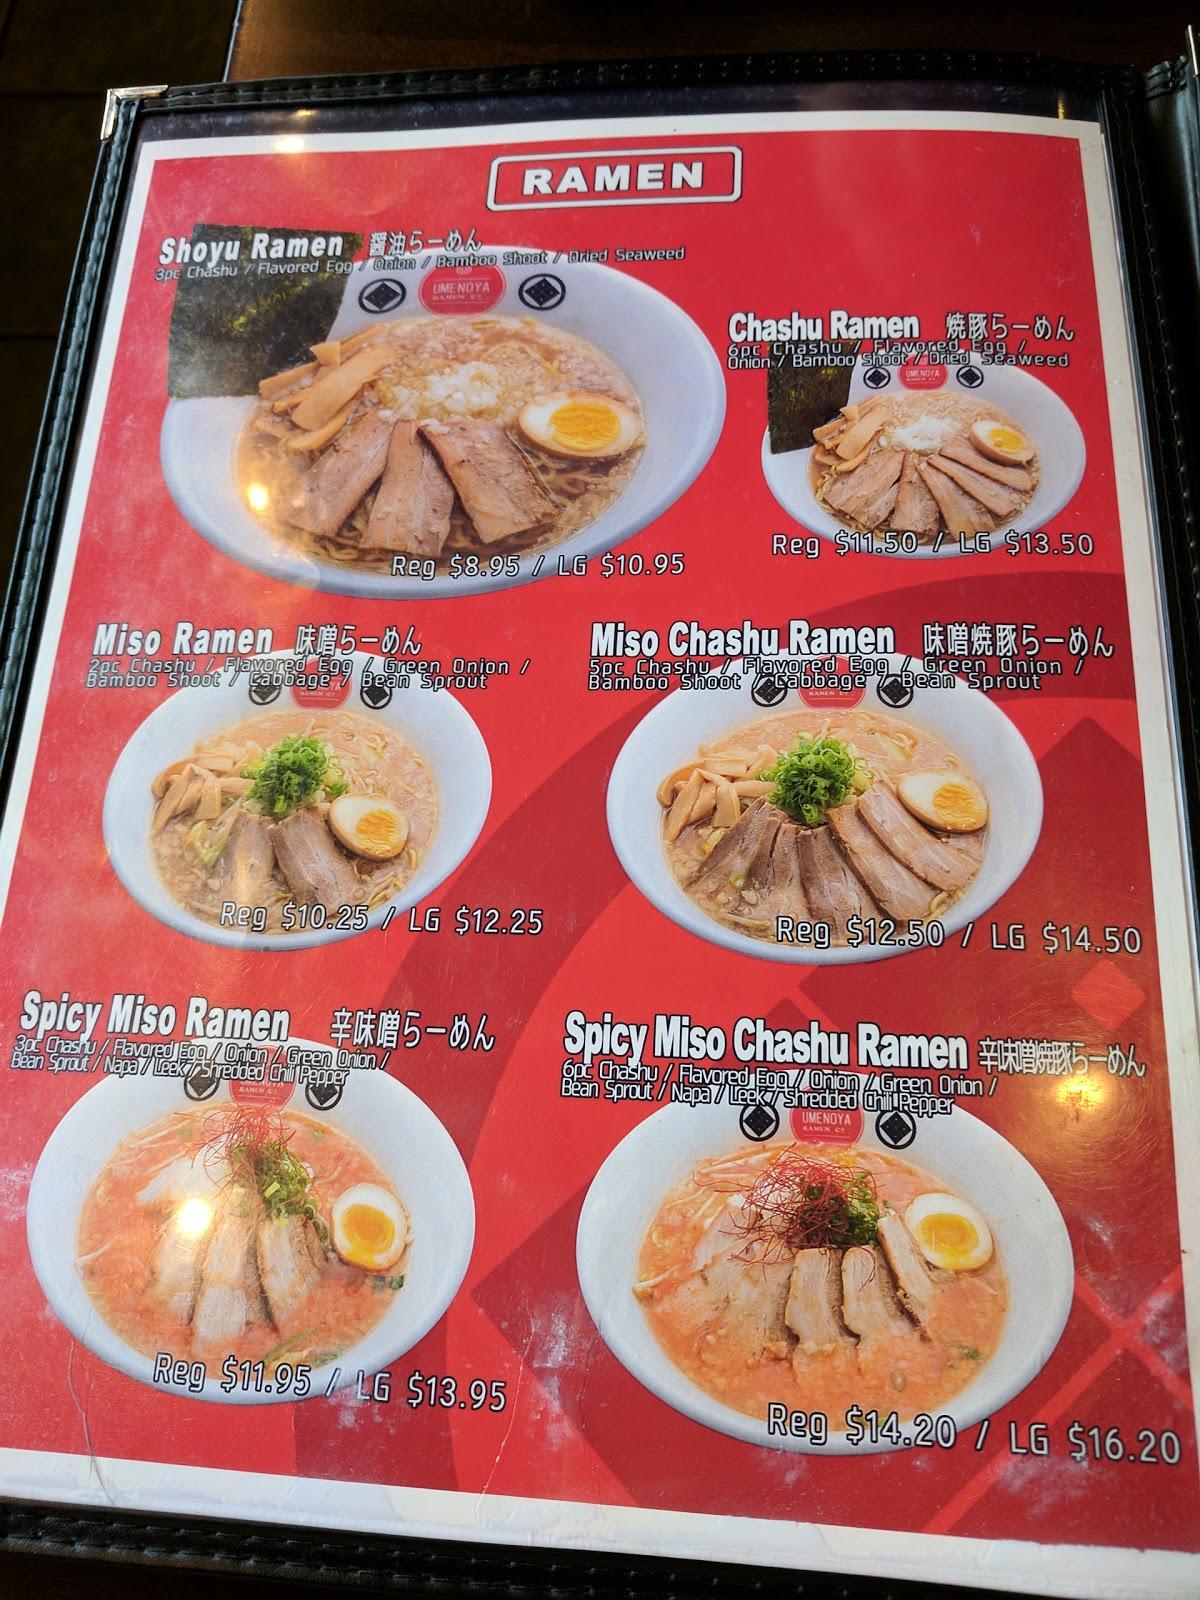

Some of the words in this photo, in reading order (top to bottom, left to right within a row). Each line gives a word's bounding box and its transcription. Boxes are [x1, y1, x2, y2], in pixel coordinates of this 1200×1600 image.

[522, 161, 704, 196] RAMEN
[159, 237, 240, 268] Shoyu
[251, 233, 344, 259] Ramen
[369, 228, 482, 257] 醤油らーめん
[155, 268, 180, 282] 3pc
[187, 264, 238, 279] Chashu
[257, 261, 320, 275] Flavored
[326, 260, 353, 274] Egg
[374, 256, 416, 271] Onion
[436, 254, 497, 268] Bamboo
[503, 251, 548, 265] Shoot
[567, 249, 608, 264] Dried
[615, 245, 686, 263] Seaweed
[432, 281, 491, 294] UMENOYA
[728, 311, 823, 342] Chashu
[830, 309, 920, 340] Ramen
[946, 312, 1074, 341] 焼豚らーめん
[727, 356, 771, 369] Onion
[778, 355, 786, 368] /
[792, 354, 855, 368] Bamboo
[862, 352, 908, 367] Shoot
[929, 351, 970, 365] Dried
[981, 352, 1070, 367] Seaweed
[728, 343, 761, 358] 6pc
[773, 341, 842, 356] Chashu
[853, 340, 861, 353] /
[874, 339, 959, 353] Flavored
[971, 339, 1007, 354] Egg
[1019, 340, 1026, 353] /
[771, 534, 820, 559] Reg
[834, 530, 918, 556] $11.50
[933, 531, 944, 553] /
[959, 531, 990, 554] LG
[1005, 530, 1094, 556] $13.50
[390, 555, 436, 581] Reg
[450, 552, 520, 578] $8.95
[532, 554, 546, 576] /
[557, 555, 588, 576] LG
[601, 552, 685, 578] $10.95
[91, 622, 161, 656] Miso
[172, 621, 273, 655] Ramen
[295, 624, 421, 656] 味噌らーめん
[590, 622, 659, 657] Miso
[668, 620, 779, 656] Chashu
[789, 619, 895, 655] Ramen
[922, 622, 1114, 657] 味噌焼豚らーめん
[86, 672, 158, 688] Bamboo
[167, 672, 221, 687] Shoot
[250, 672, 331, 690] Cabbage
[361, 672, 409, 688] Bean
[421, 673, 488, 691] Sprout
[88, 658, 120, 673] 2pc
[130, 657, 196, 673] Chashu
[205, 657, 215, 671] /
[224, 655, 306, 672] Flavored
[318, 656, 353, 674] Egg
[364, 657, 374, 671] /
[384, 658, 440, 674] Green
[452, 658, 509, 674] Onion
[520, 659, 531, 674] /
[588, 659, 624, 676] 5pc
[636, 659, 710, 674] Chashu
[721, 658, 731, 674] /
[742, 657, 836, 674] Flavored
[849, 656, 889, 675] Egg
[900, 655, 912, 673] /
[923, 656, 987, 673] Green
[1000, 657, 1061, 674] Onion
[1074, 659, 1084, 675] /
[588, 674, 669, 690] Bamboo
[679, 673, 742, 690] Shoot
[752, 673, 761, 689] /
[774, 672, 866, 691] Cabbage
[901, 671, 956, 688] Bean
[968, 673, 1040, 691] Sprout
[219, 902, 268, 932] Reg
[281, 901, 369, 930] $10.25
[381, 905, 396, 930] /
[408, 907, 442, 932] LG
[455, 905, 544, 936] $12.25
[775, 916, 831, 949] Reg
[847, 914, 945, 948] $12.50
[960, 921, 974, 949] /
[991, 923, 1026, 950] LG
[1042, 922, 1142, 954] $14.50
[20, 990, 103, 1041] Spicy
[107, 993, 177, 1036] Miso
[184, 996, 290, 1041] Ramen
[330, 1007, 495, 1051] 辛味噌らーめん
[14, 1034, 42, 1054] 3pc
[46, 1036, 96, 1055] Chashu
[100, 1038, 109, 1055] /
[114, 1038, 175, 1058] Flavored
[211, 1042, 222, 1058] /
[224, 1043, 268, 1064] Onion
[273, 1046, 283, 1063] /
[288, 1047, 332, 1067] Green
[336, 1049, 376, 1069] Onion
[380, 1052, 390, 1070] /
[563, 1010, 648, 1066] Spicy
[654, 1014, 726, 1060] Miso
[733, 1016, 849, 1065] Chashu
[857, 1022, 968, 1070] Ramen
[978, 1036, 1146, 1077] 辛味噌焼豚らーめん
[10, 1051, 44, 1070] Bean
[48, 1053, 89, 1075] Sprout
[91, 1056, 101, 1072] /
[103, 1056, 139, 1076] Napa
[140, 1056, 151, 1075] /
[153, 1057, 185, 1077] Leek
[201, 1059, 265, 1081] Shredded
[269, 1063, 295, 1084] Chili
[299, 1065, 349, 1087] Pepper
[562, 1059, 593, 1079] 6pc
[599, 1060, 658, 1082] Chashu
[663, 1063, 674, 1081] /
[678, 1064, 750, 1086] Flavored
[794, 1070, 806, 1088] /
[810, 1070, 859, 1091] Onion
[864, 1073, 875, 1091] /
[880, 1074, 932, 1094] Green
[939, 1076, 983, 1096] Onion
[988, 1077, 998, 1096] /
[561, 1077, 599, 1098] Bean
[604, 1080, 653, 1103] Sprout
[657, 1083, 668, 1101] /
[671, 1083, 711, 1107] Napa
[714, 1084, 725, 1104] /
[729, 1085, 766, 1105] Leek
[784, 1087, 858, 1110] Shredded
[863, 1091, 893, 1112] Chili
[899, 1093, 954, 1117] Pepper
[801, 1111, 852, 1126] UMENOYA
[153, 1352, 205, 1393] Reg
[221, 1354, 312, 1396] $11.95
[325, 1367, 342, 1397] /
[356, 1369, 391, 1402] LG
[408, 1370, 507, 1412] $13.95
[767, 1402, 828, 1446] Reg
[845, 1405, 958, 1449] $14.20
[975, 1419, 991, 1452] /
[1009, 1421, 1050, 1456] LG
[1068, 1421, 1182, 1465] $16.20
